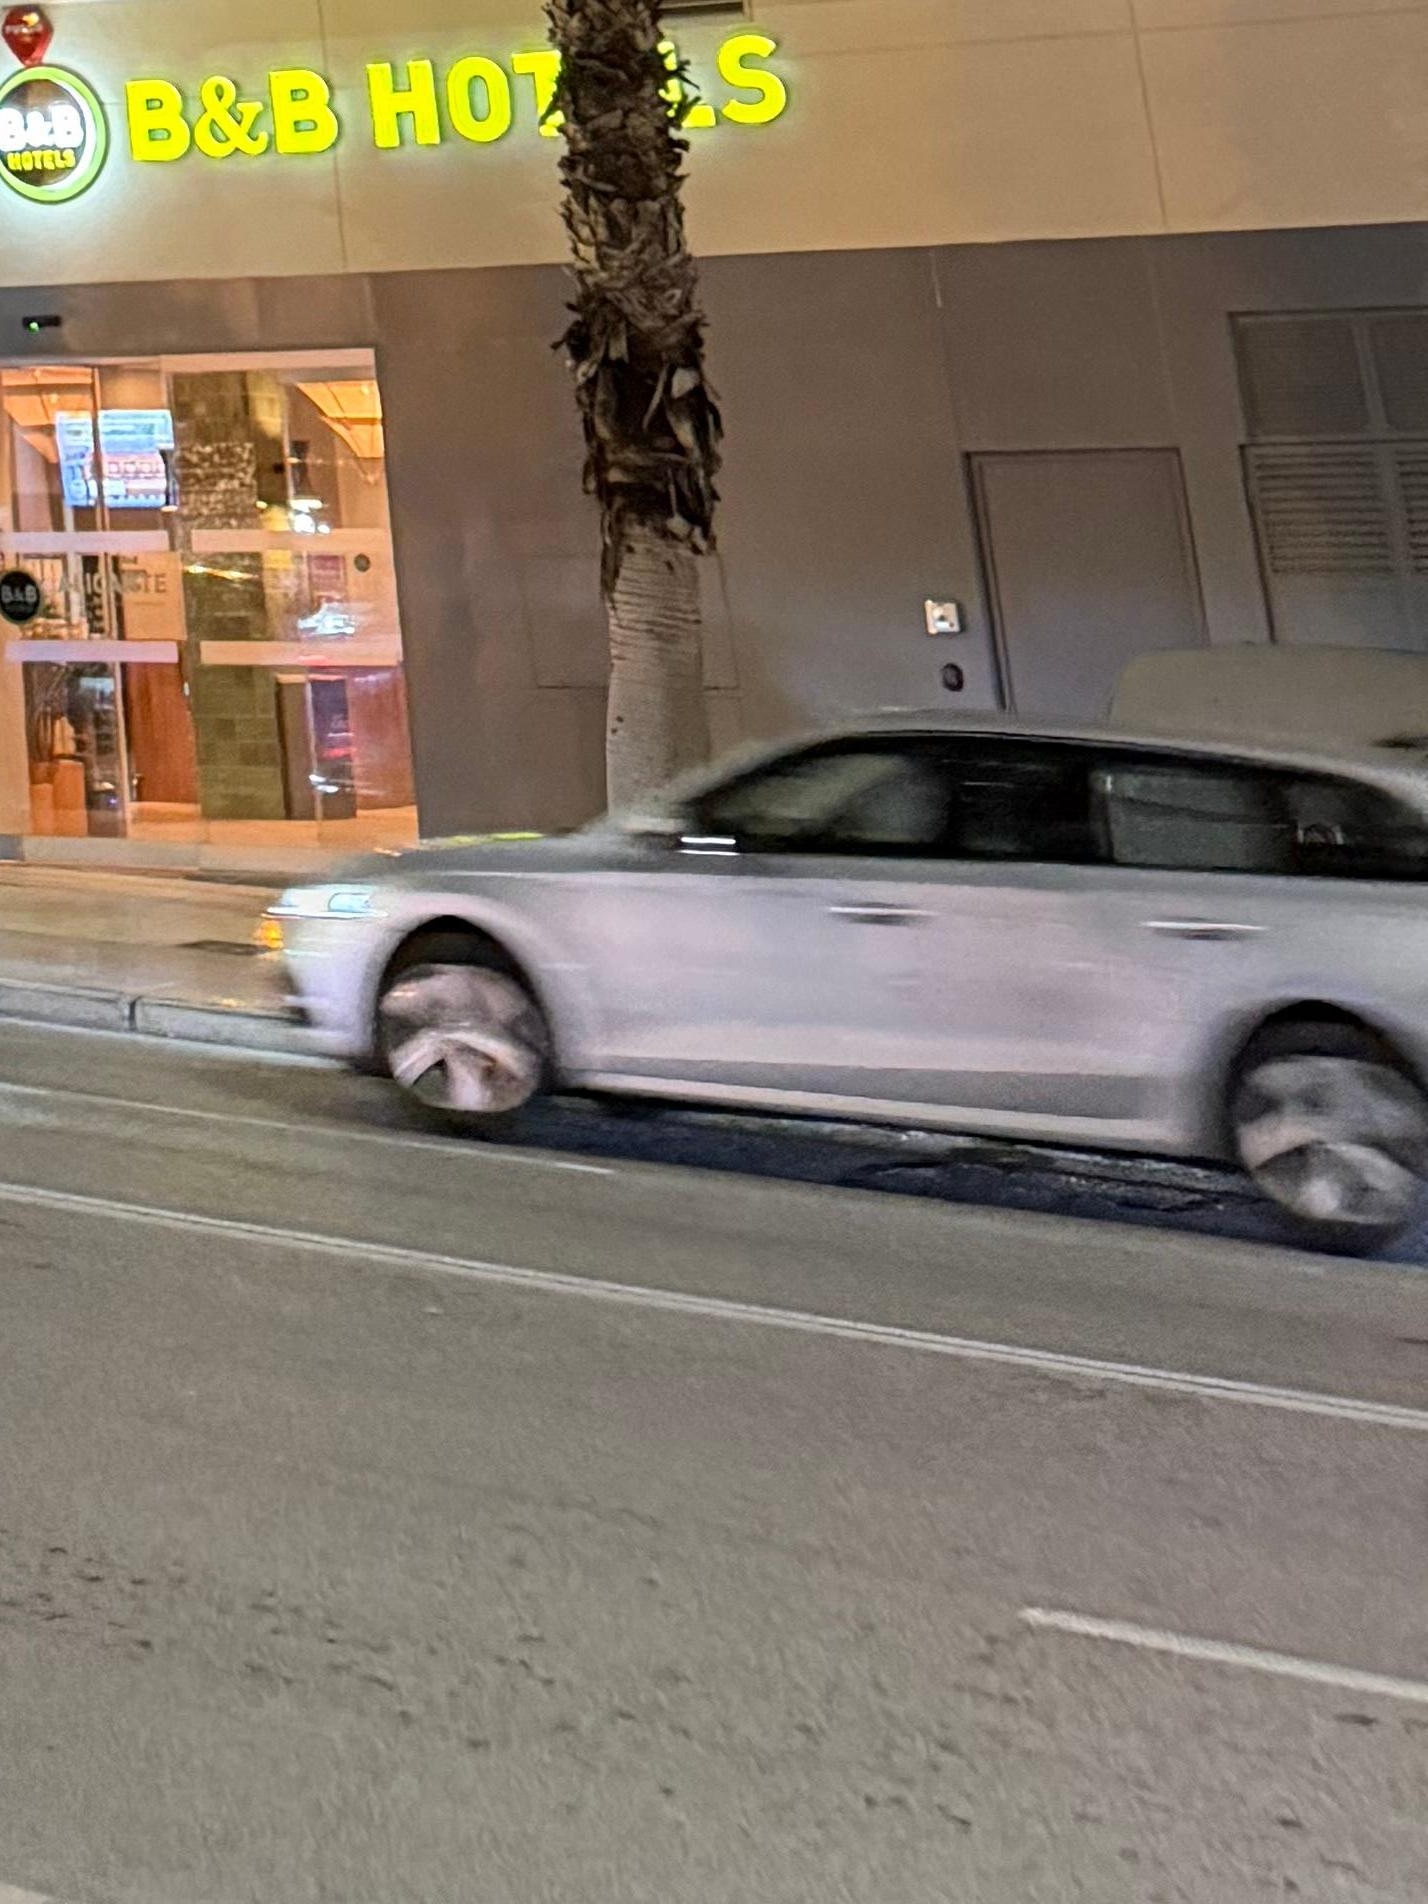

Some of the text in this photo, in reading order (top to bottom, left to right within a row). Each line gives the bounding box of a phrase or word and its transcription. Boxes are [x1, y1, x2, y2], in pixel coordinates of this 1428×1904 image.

[125, 35, 787, 161] B&B HOTLS
[7, 149, 76, 171] HOTELS
